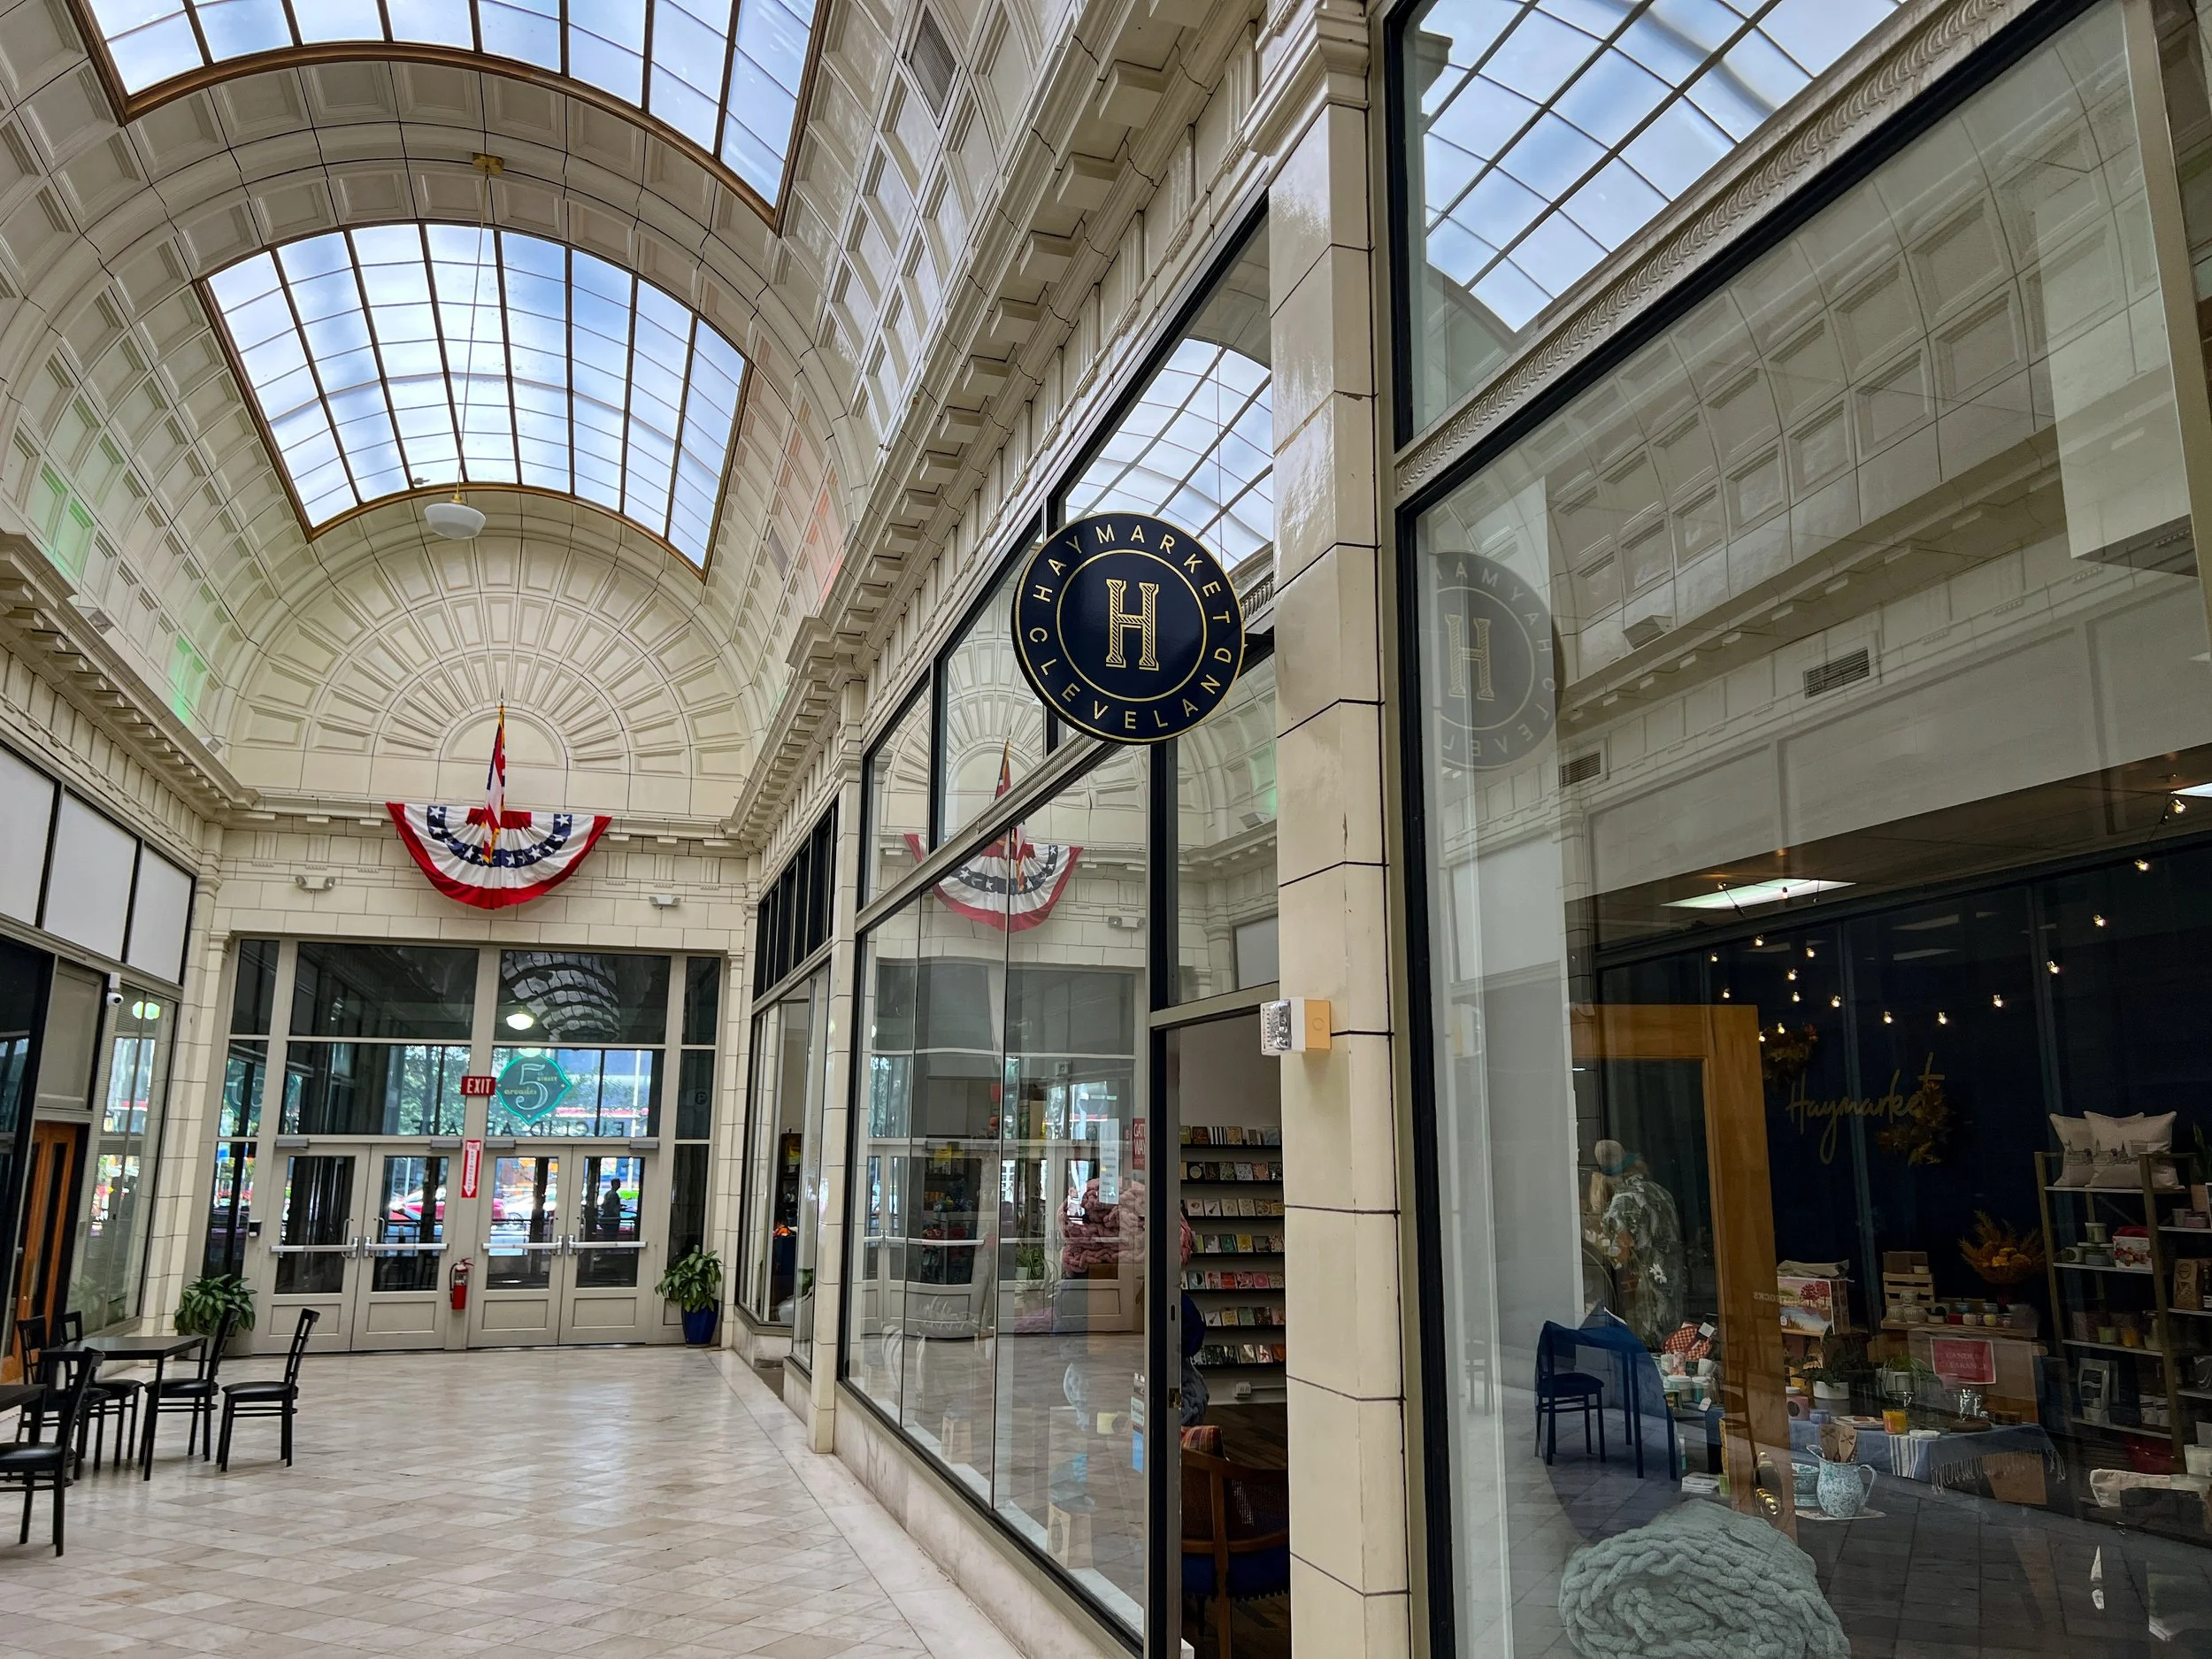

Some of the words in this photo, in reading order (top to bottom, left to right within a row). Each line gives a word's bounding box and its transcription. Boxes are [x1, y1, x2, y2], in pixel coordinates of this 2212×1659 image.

[1033, 524, 1231, 624] HAYMARKET
[1106, 579, 1159, 672] H
[1029, 626, 1232, 730] CLEVELAND
[466, 1078, 492, 1094] EXIT
[1786, 1051, 1946, 1165] Haymarket
